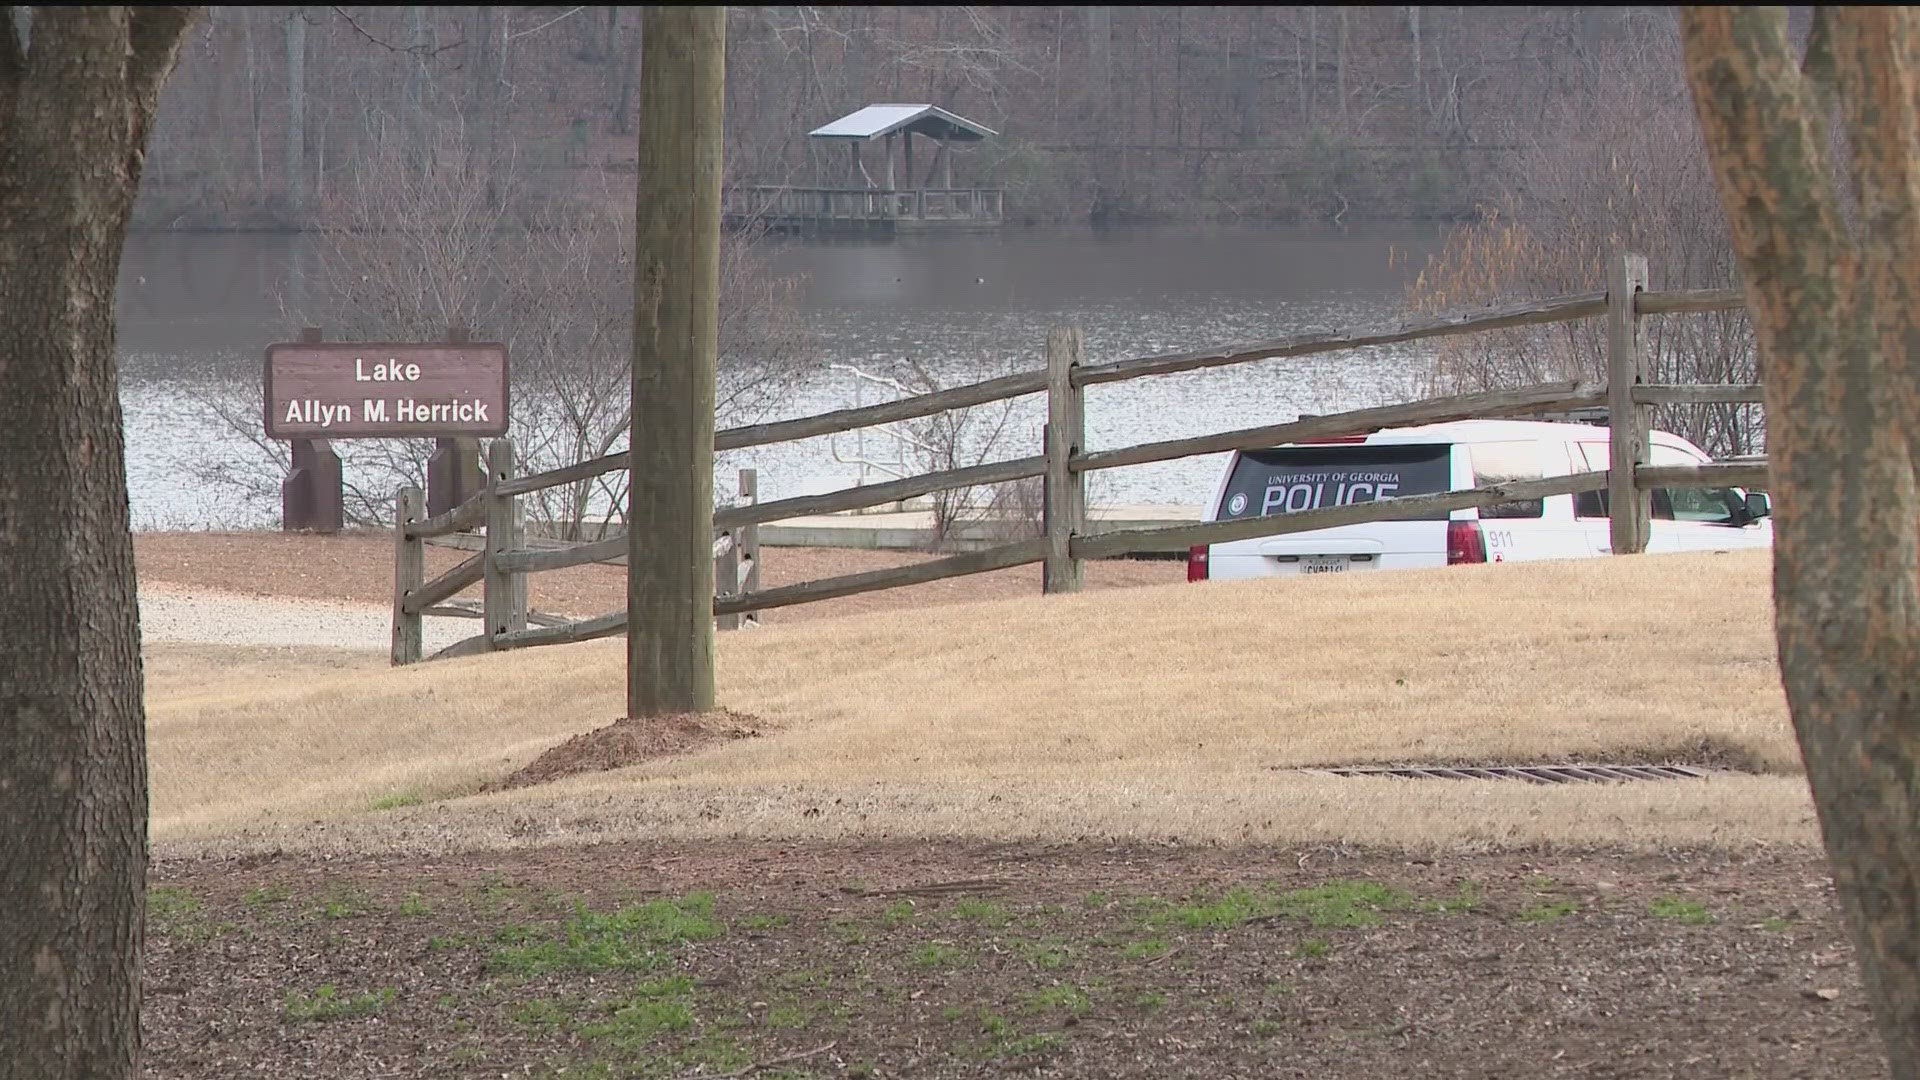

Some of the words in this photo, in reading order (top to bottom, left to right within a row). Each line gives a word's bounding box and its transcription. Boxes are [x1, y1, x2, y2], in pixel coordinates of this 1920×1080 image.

[355, 358, 421, 382] Lake
[285, 399, 351, 427] Allyn
[363, 399, 390, 422] M.
[397, 399, 489, 423] Herrick
[1268, 472, 1330, 485] UNIVERSITY
[1332, 472, 1348, 482] OF
[1349, 472, 1400, 483] GEORGIA
[1489, 530, 1514, 548] 911
